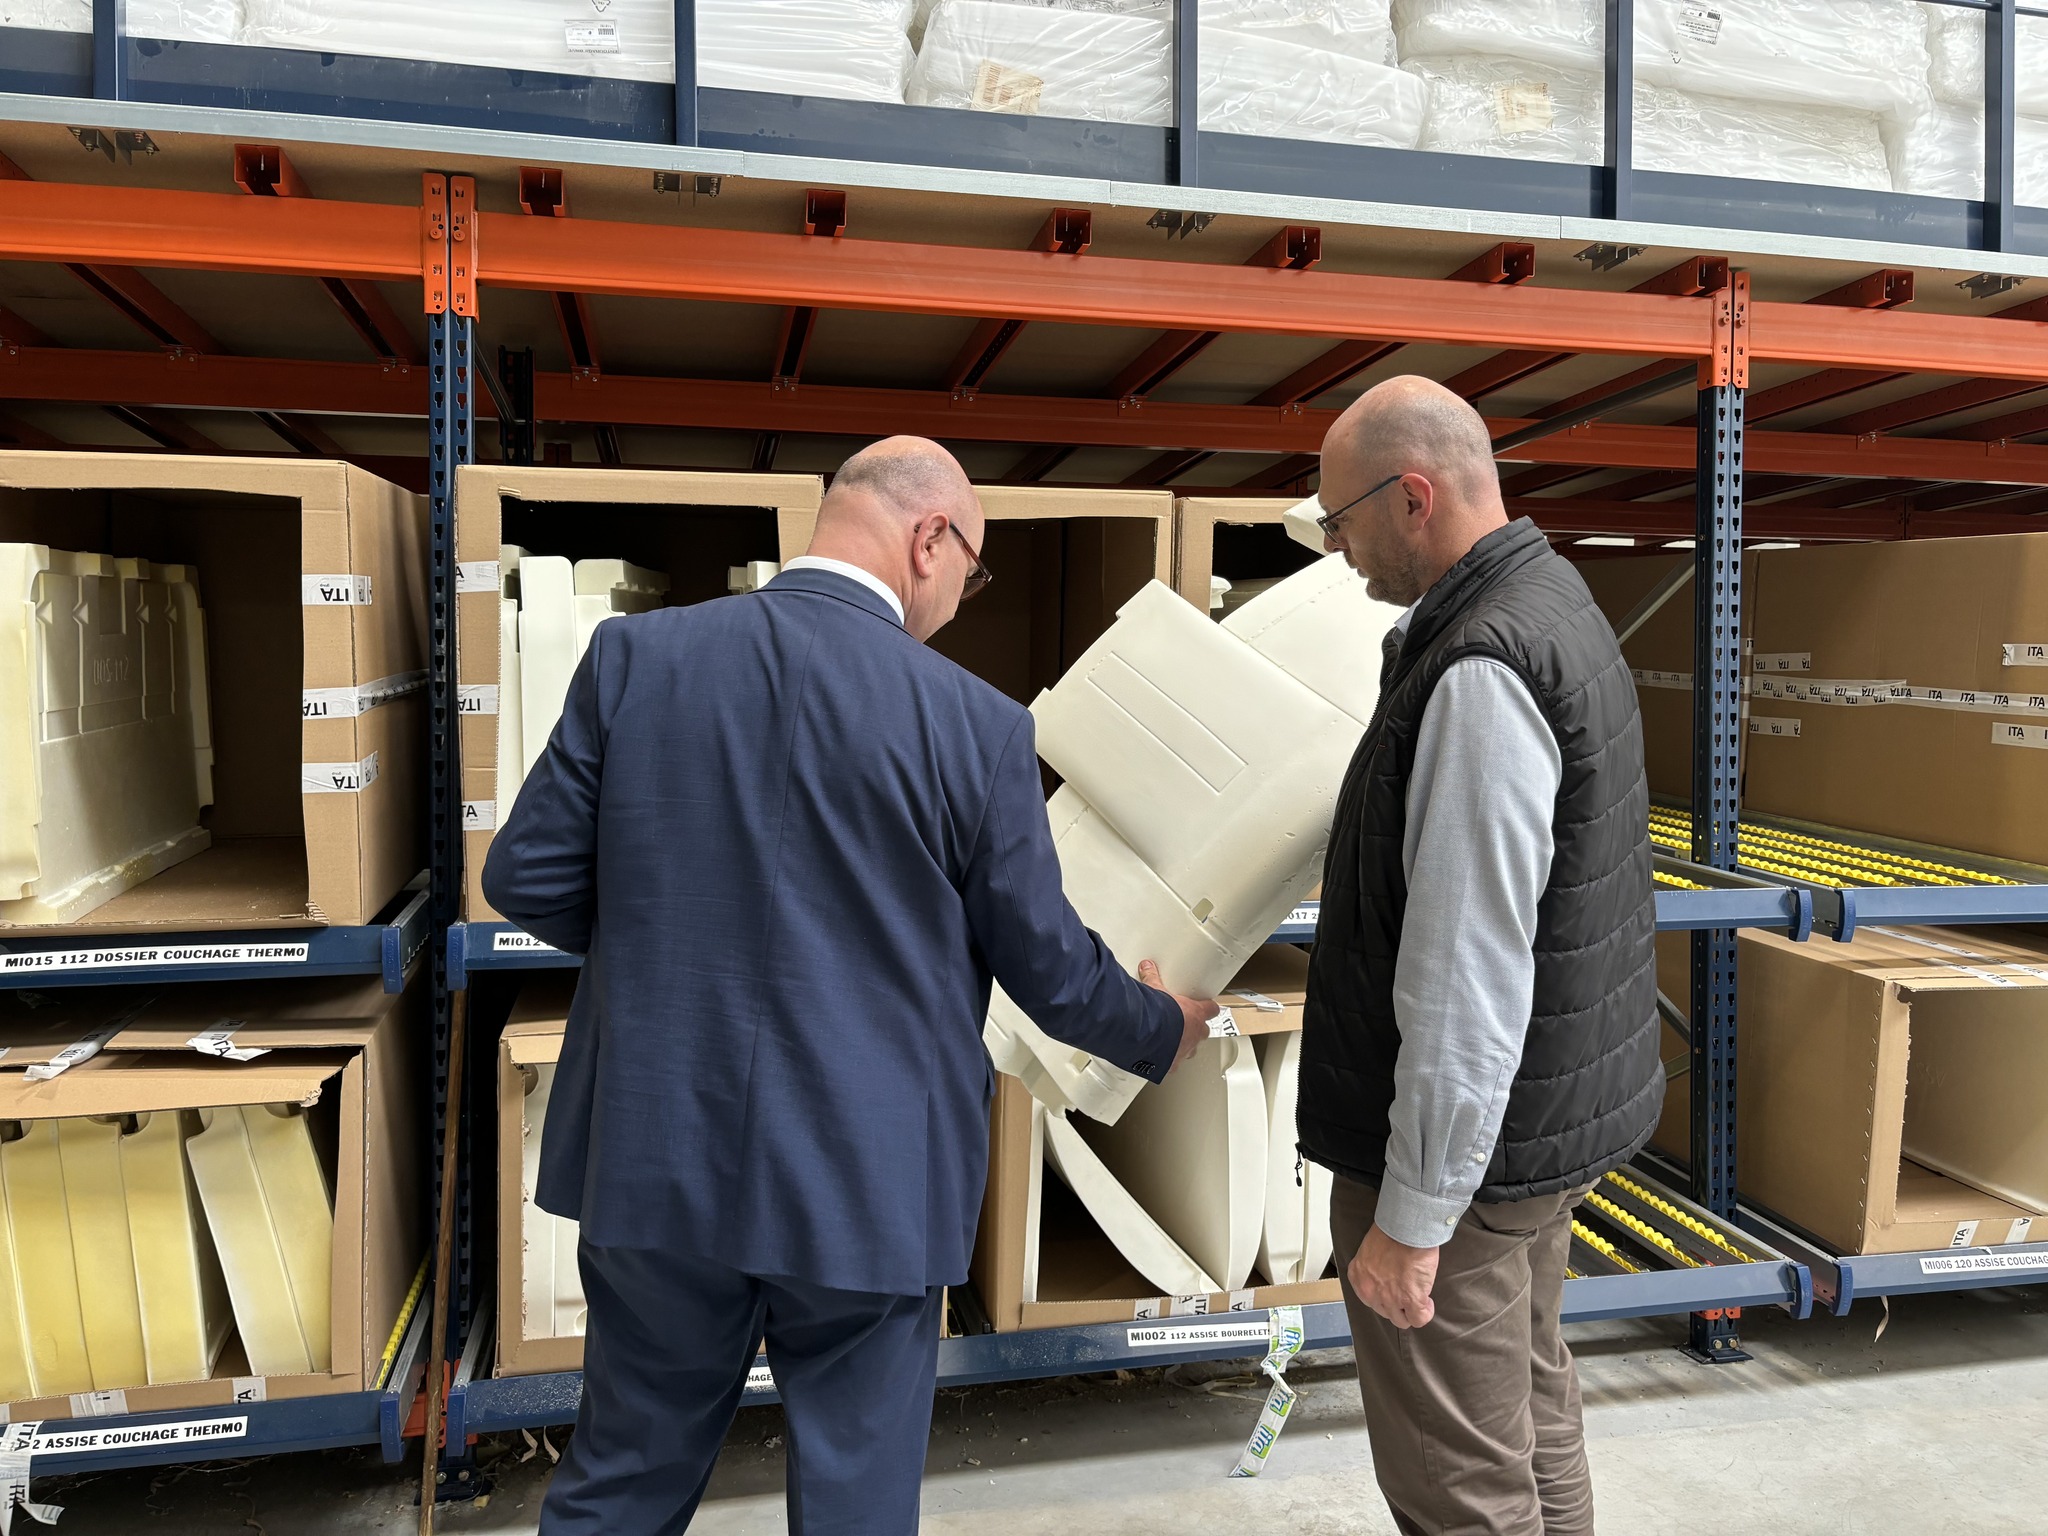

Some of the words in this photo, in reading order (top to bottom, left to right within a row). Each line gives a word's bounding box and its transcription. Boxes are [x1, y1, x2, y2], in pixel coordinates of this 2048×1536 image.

[320, 588, 349, 602] ITA
[2027, 646, 2044, 657] ITA
[1928, 690, 1942, 700] ITA
[1960, 692, 1975, 703] ITA
[1993, 695, 2009, 705] ITA
[2028, 696, 2045, 708] ITA
[2008, 726, 2025, 737] ITA
[332, 776, 359, 790] ITA
[498, 937, 541, 946] MI012
[5, 956, 53, 967] MI015
[60, 954, 88, 965] 112
[94, 951, 157, 963] DOSSIER
[163, 948, 241, 960] COUCHAGE
[247, 947, 305, 958] THERMO
[1952, 1228, 1967, 1245] ITA
[1924, 1260, 1953, 1270] MI006
[1955, 1259, 1972, 1268] 120
[1974, 1258, 2005, 1267] ASSISE
[1130, 1331, 1166, 1341] MI002
[1189, 1331, 1219, 1339] ASSISE
[14, 1424, 36, 1451] ITA
[45, 1436, 98, 1449] ASSISE
[103, 1428, 179, 1444] COUCHAGE
[184, 1421, 242, 1437] THERMO
